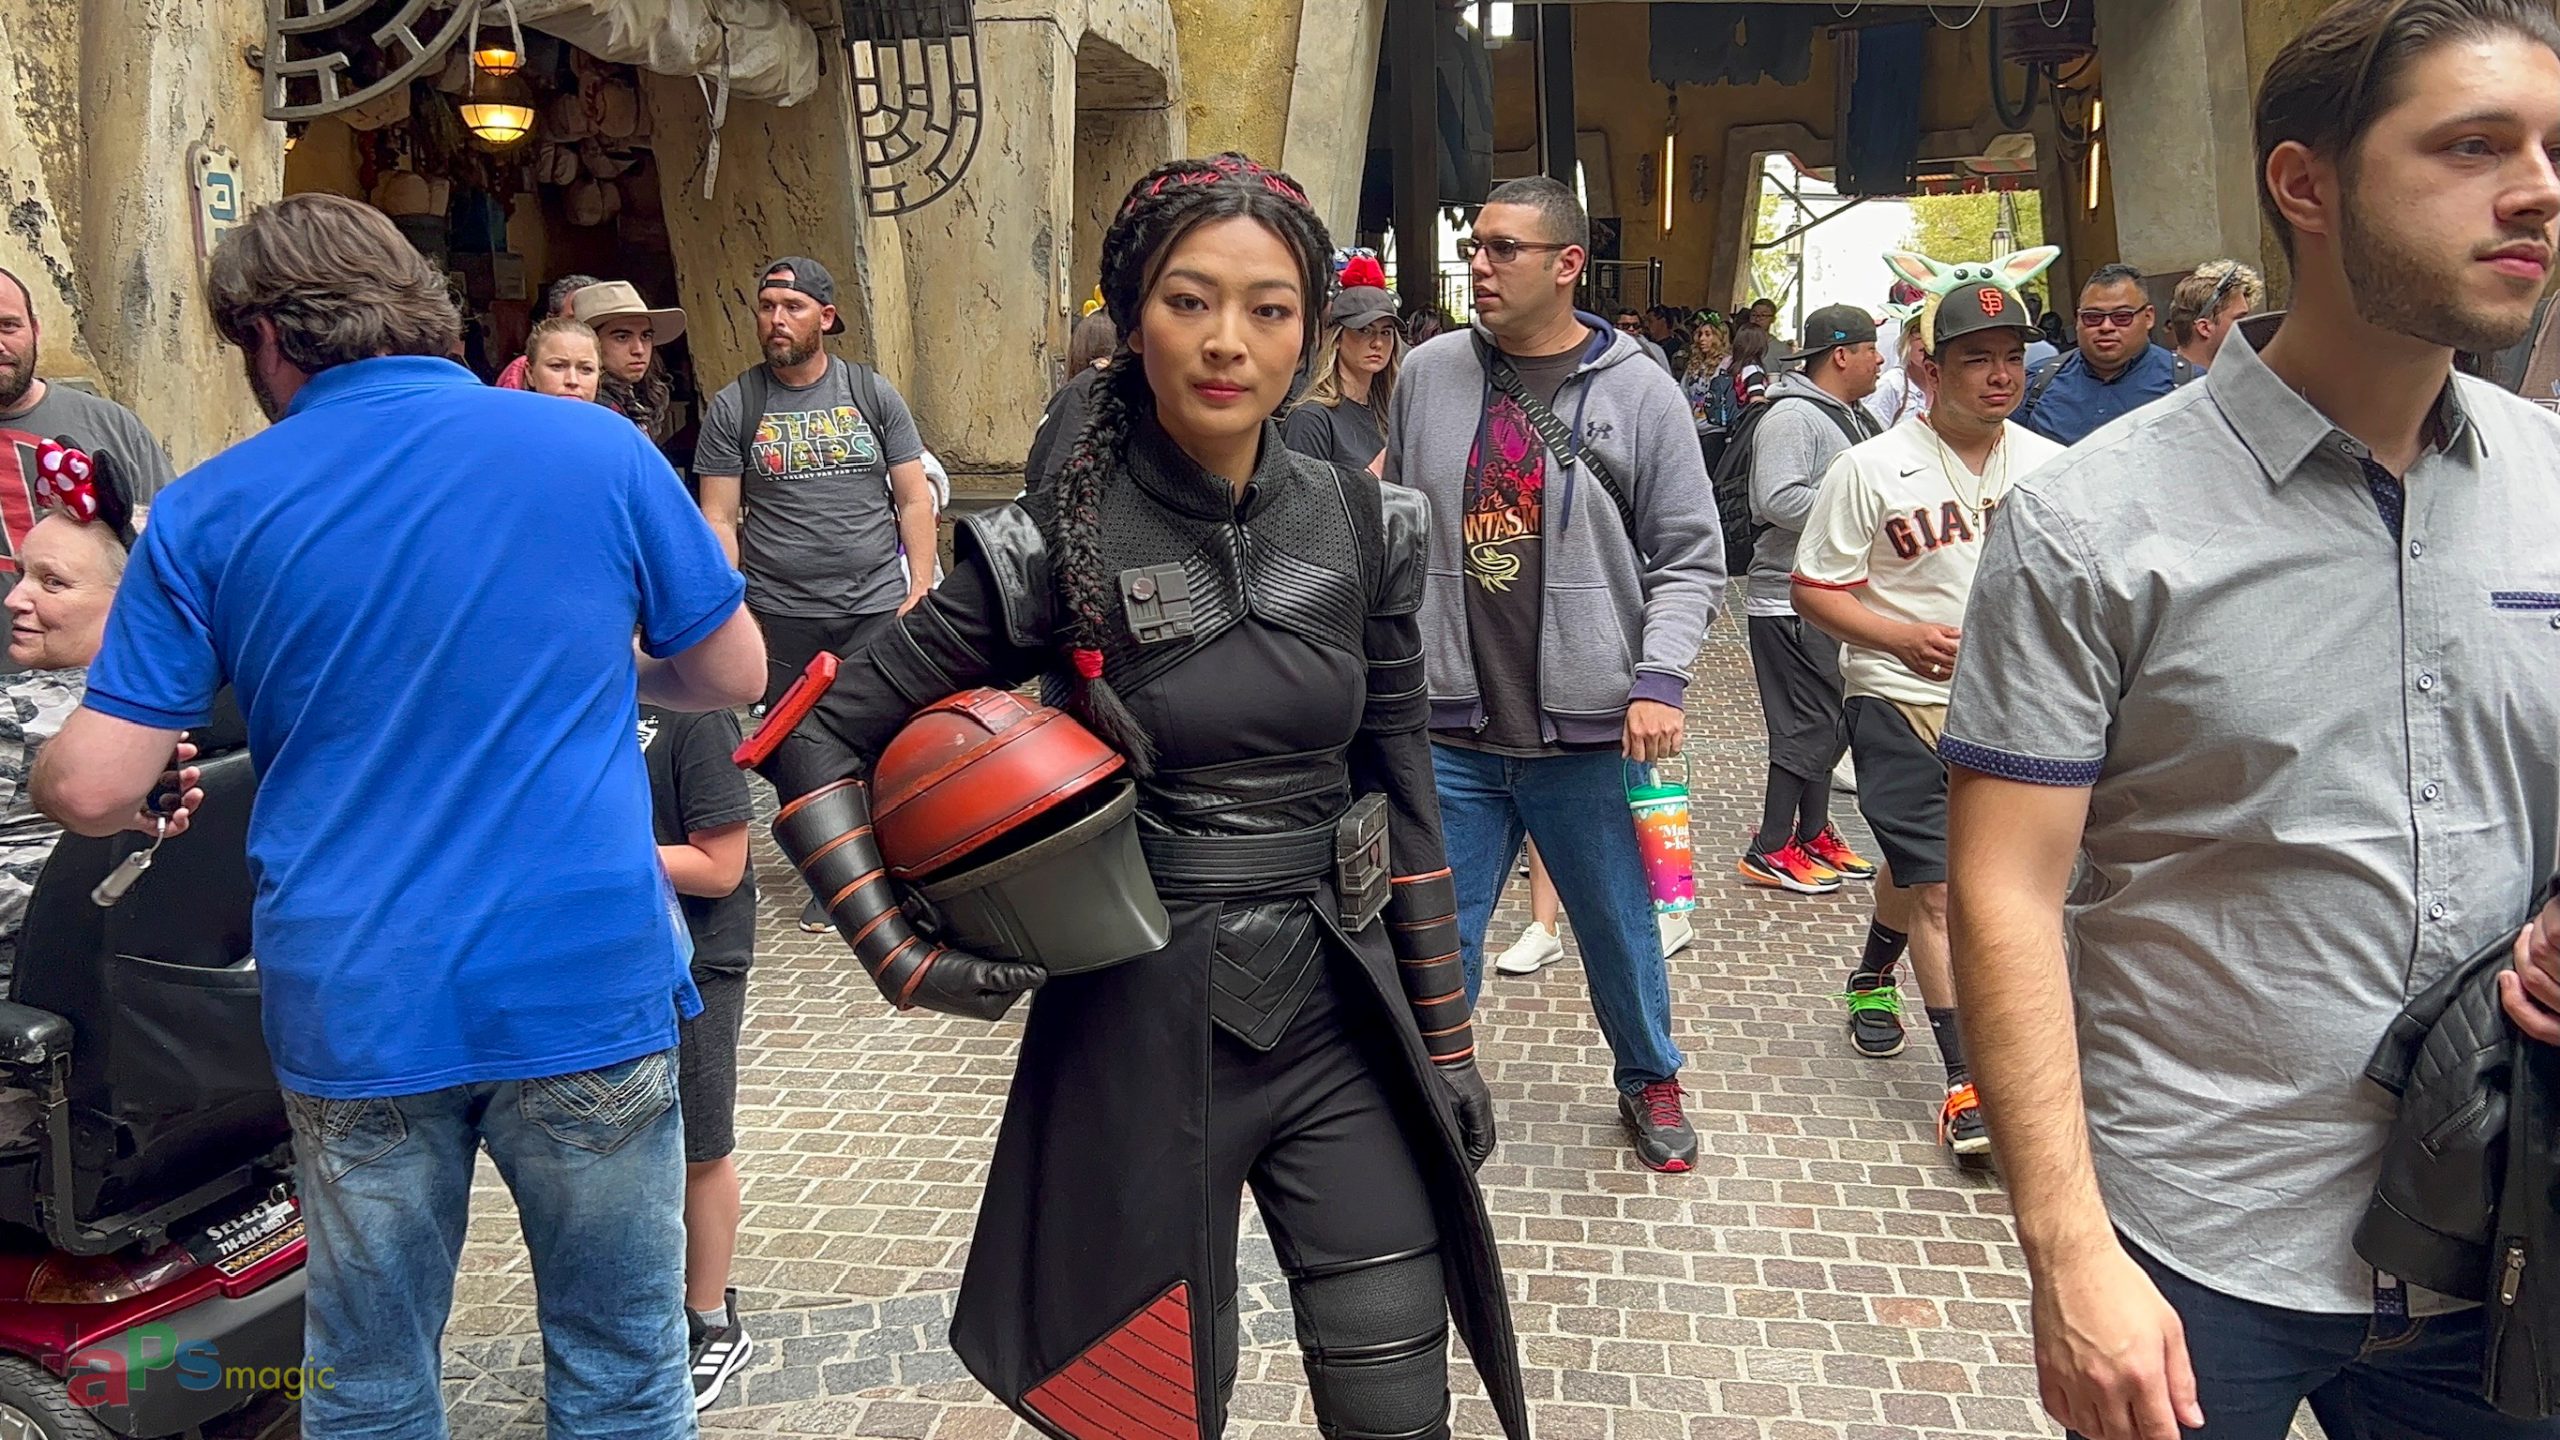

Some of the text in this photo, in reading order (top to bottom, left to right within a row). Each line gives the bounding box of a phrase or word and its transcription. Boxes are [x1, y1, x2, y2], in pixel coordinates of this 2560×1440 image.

[1978, 287, 2003, 317] SF
[753, 406, 871, 445] STAR
[750, 435, 877, 476] WARS
[783, 471, 816, 481] GALAXY
[816, 470, 833, 478] FAR
[834, 468, 850, 476] FAR
